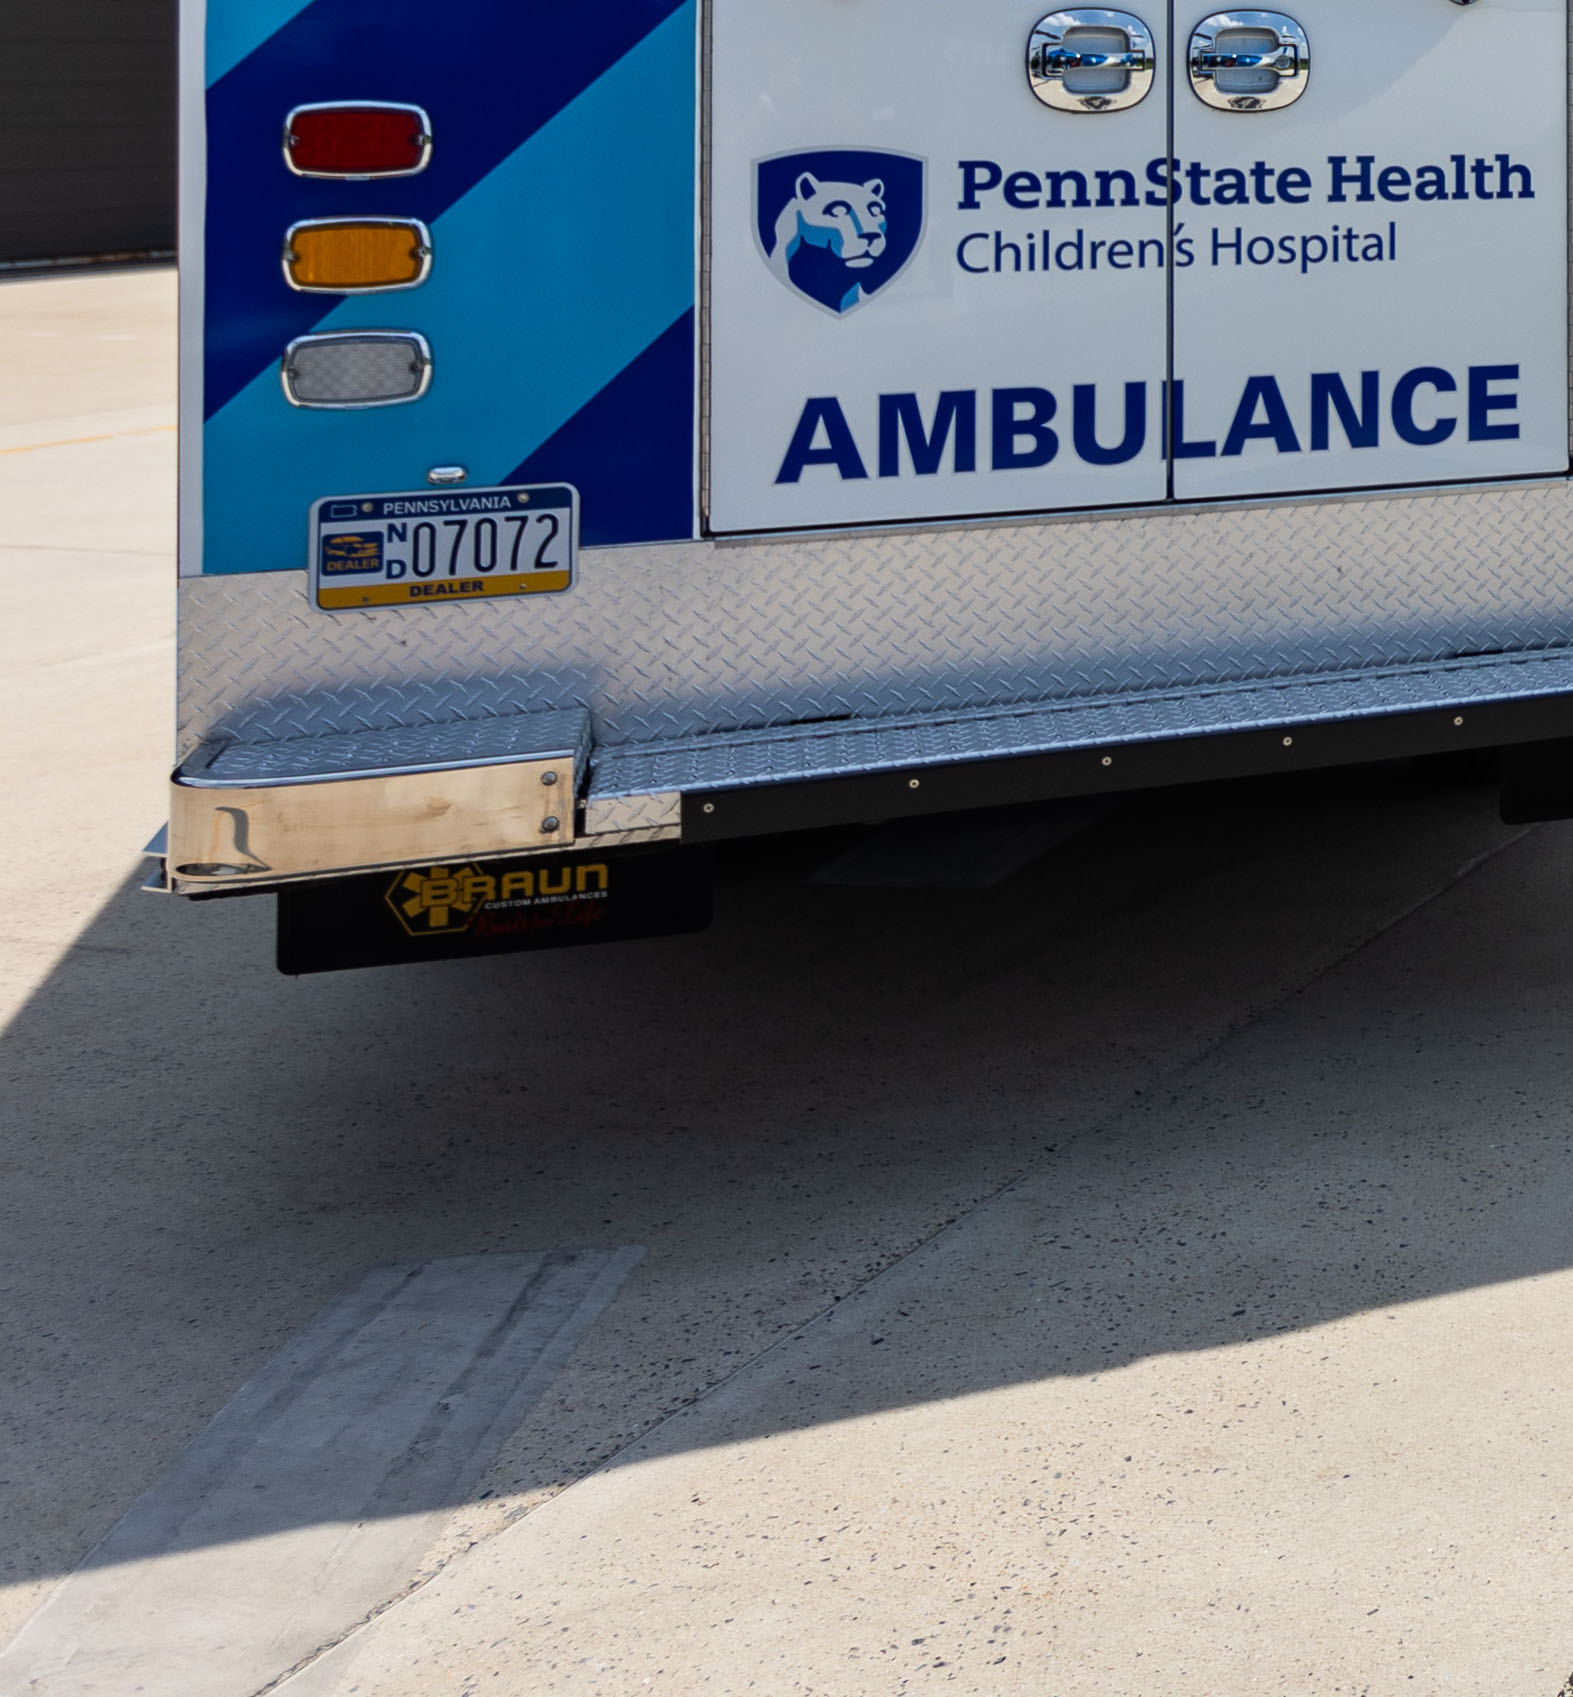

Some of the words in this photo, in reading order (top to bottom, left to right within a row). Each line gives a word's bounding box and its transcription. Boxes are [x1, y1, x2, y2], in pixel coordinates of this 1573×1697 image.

[958, 157, 1312, 210] PennState
[1326, 154, 1535, 203] Health
[956, 223, 1195, 273] Children's
[1211, 221, 1398, 274] Hospital
[773, 363, 1520, 486] AMBULANCE
[383, 496, 512, 516] PENNSYLVANIA
[387, 522, 407, 543] N
[412, 514, 559, 577] 07072
[326, 558, 380, 572] DEALER
[386, 558, 407, 580] D
[409, 580, 484, 598] DEALER
[420, 863, 608, 908] BRAUN
[484, 898, 532, 909] CUSTOM
[533, 890, 608, 905] AMBULANCES
